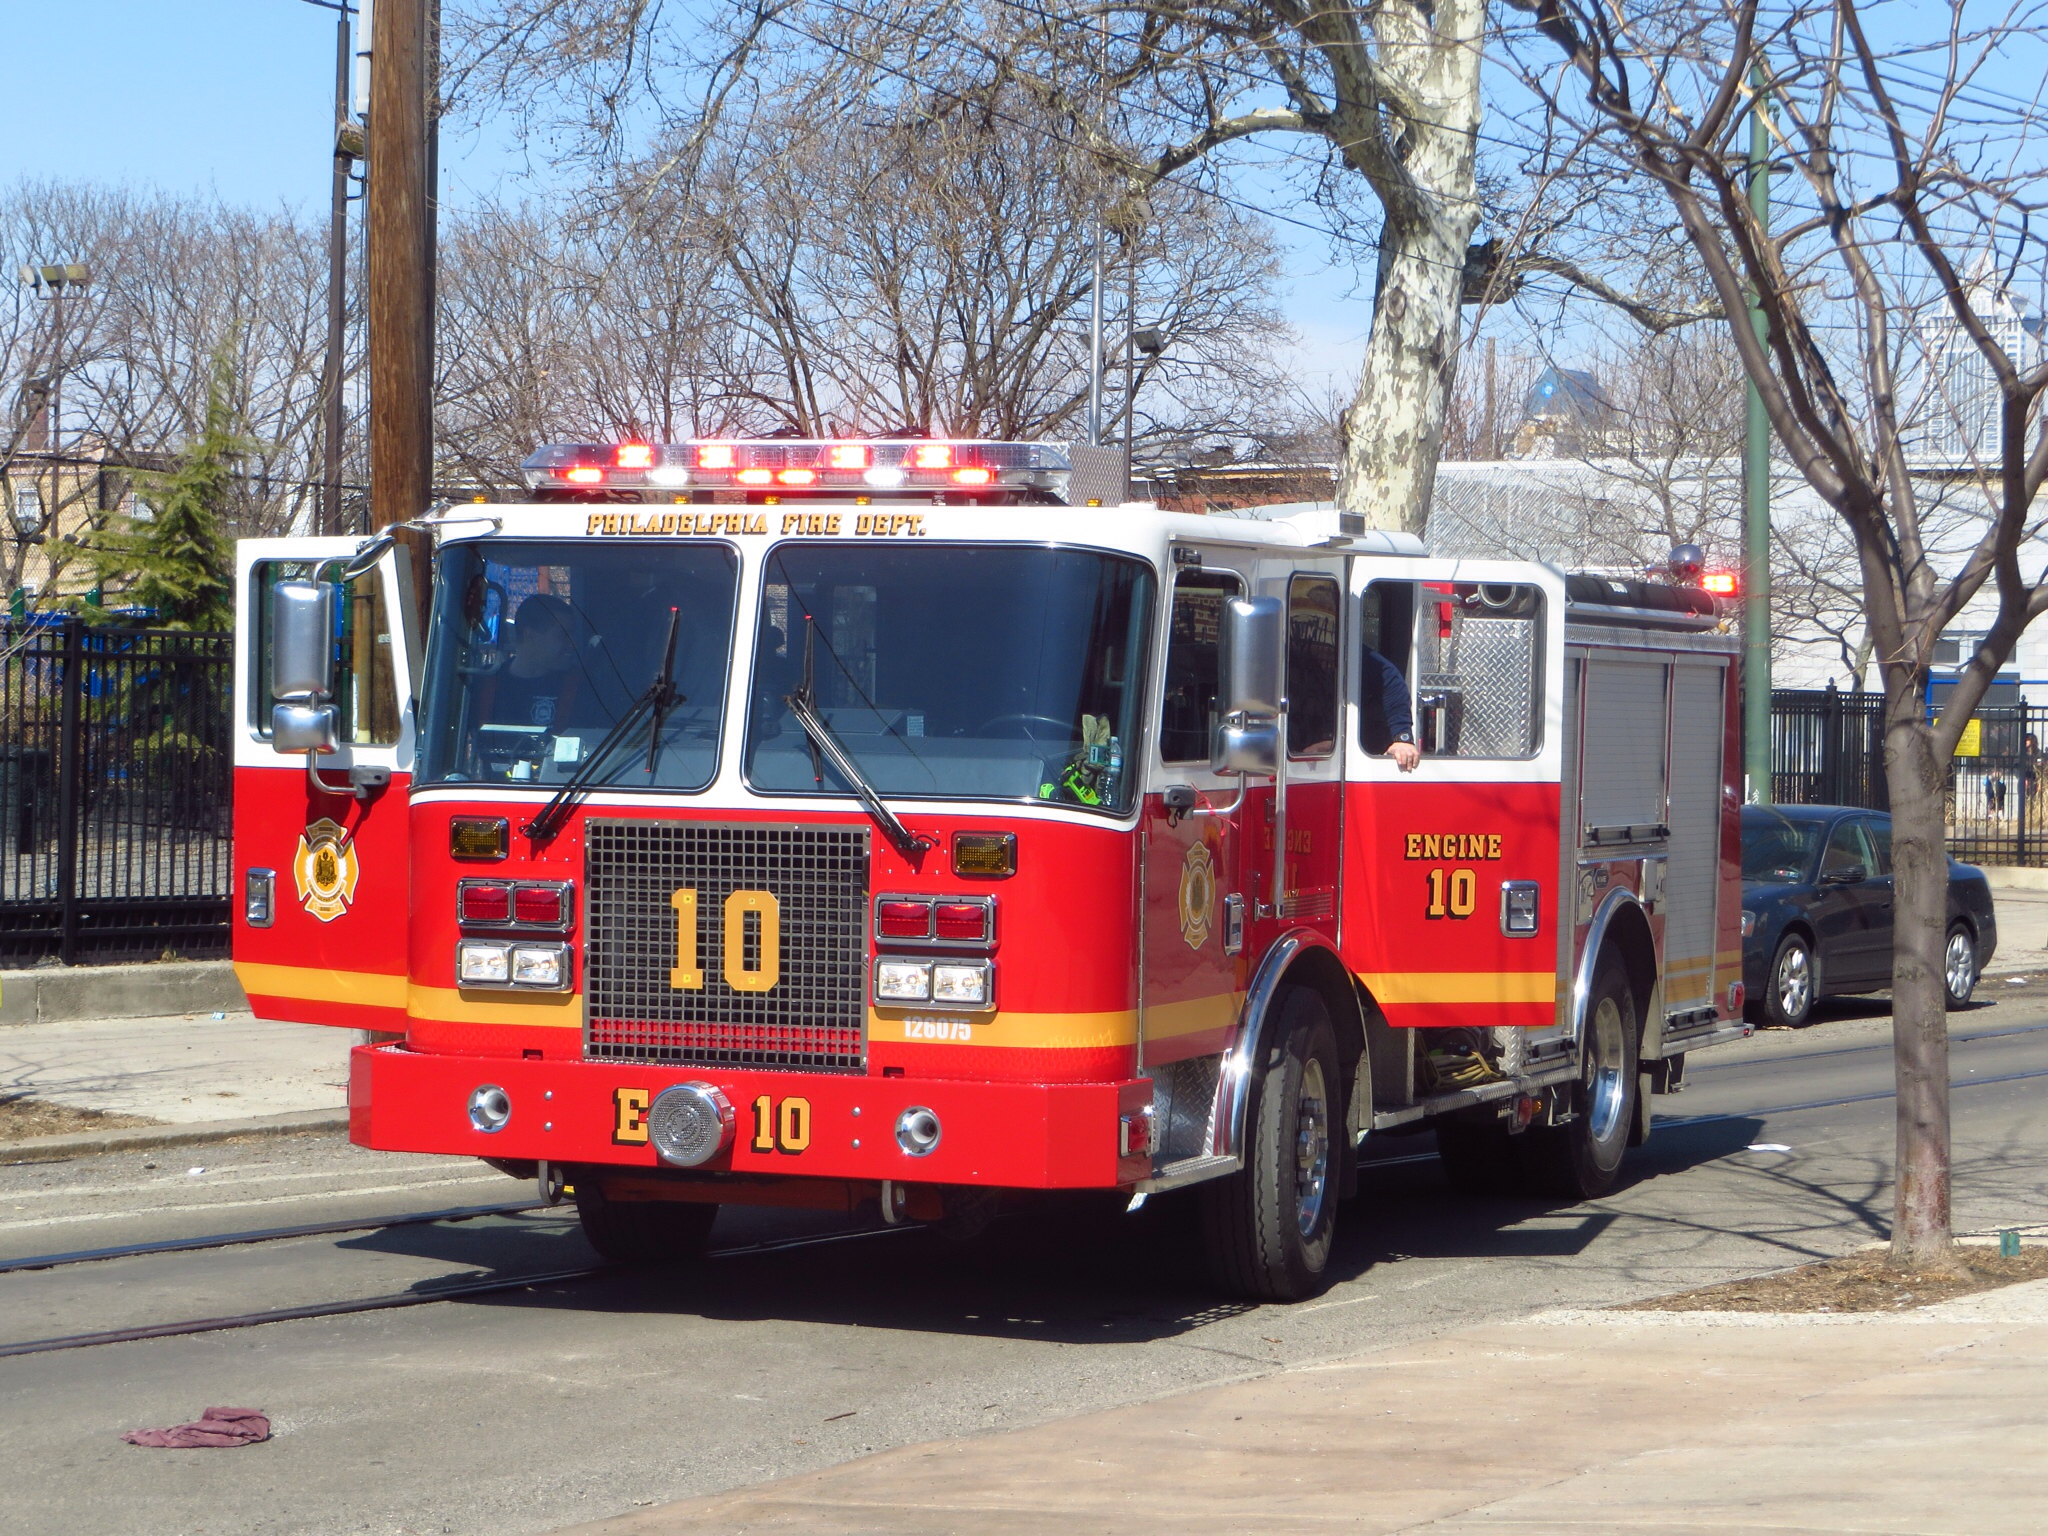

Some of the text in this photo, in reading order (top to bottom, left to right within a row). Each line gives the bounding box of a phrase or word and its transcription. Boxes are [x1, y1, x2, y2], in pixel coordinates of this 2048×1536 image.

[586, 514, 927, 535] PHILADELPHIA FIRE DEPT.
[1404, 834, 1502, 860] ENGINE
[1425, 868, 1477, 920] 10
[670, 888, 780, 992] 10
[903, 1015, 971, 1041] 126075
[612, 1088, 650, 1146] E
[752, 1095, 811, 1154] 10
